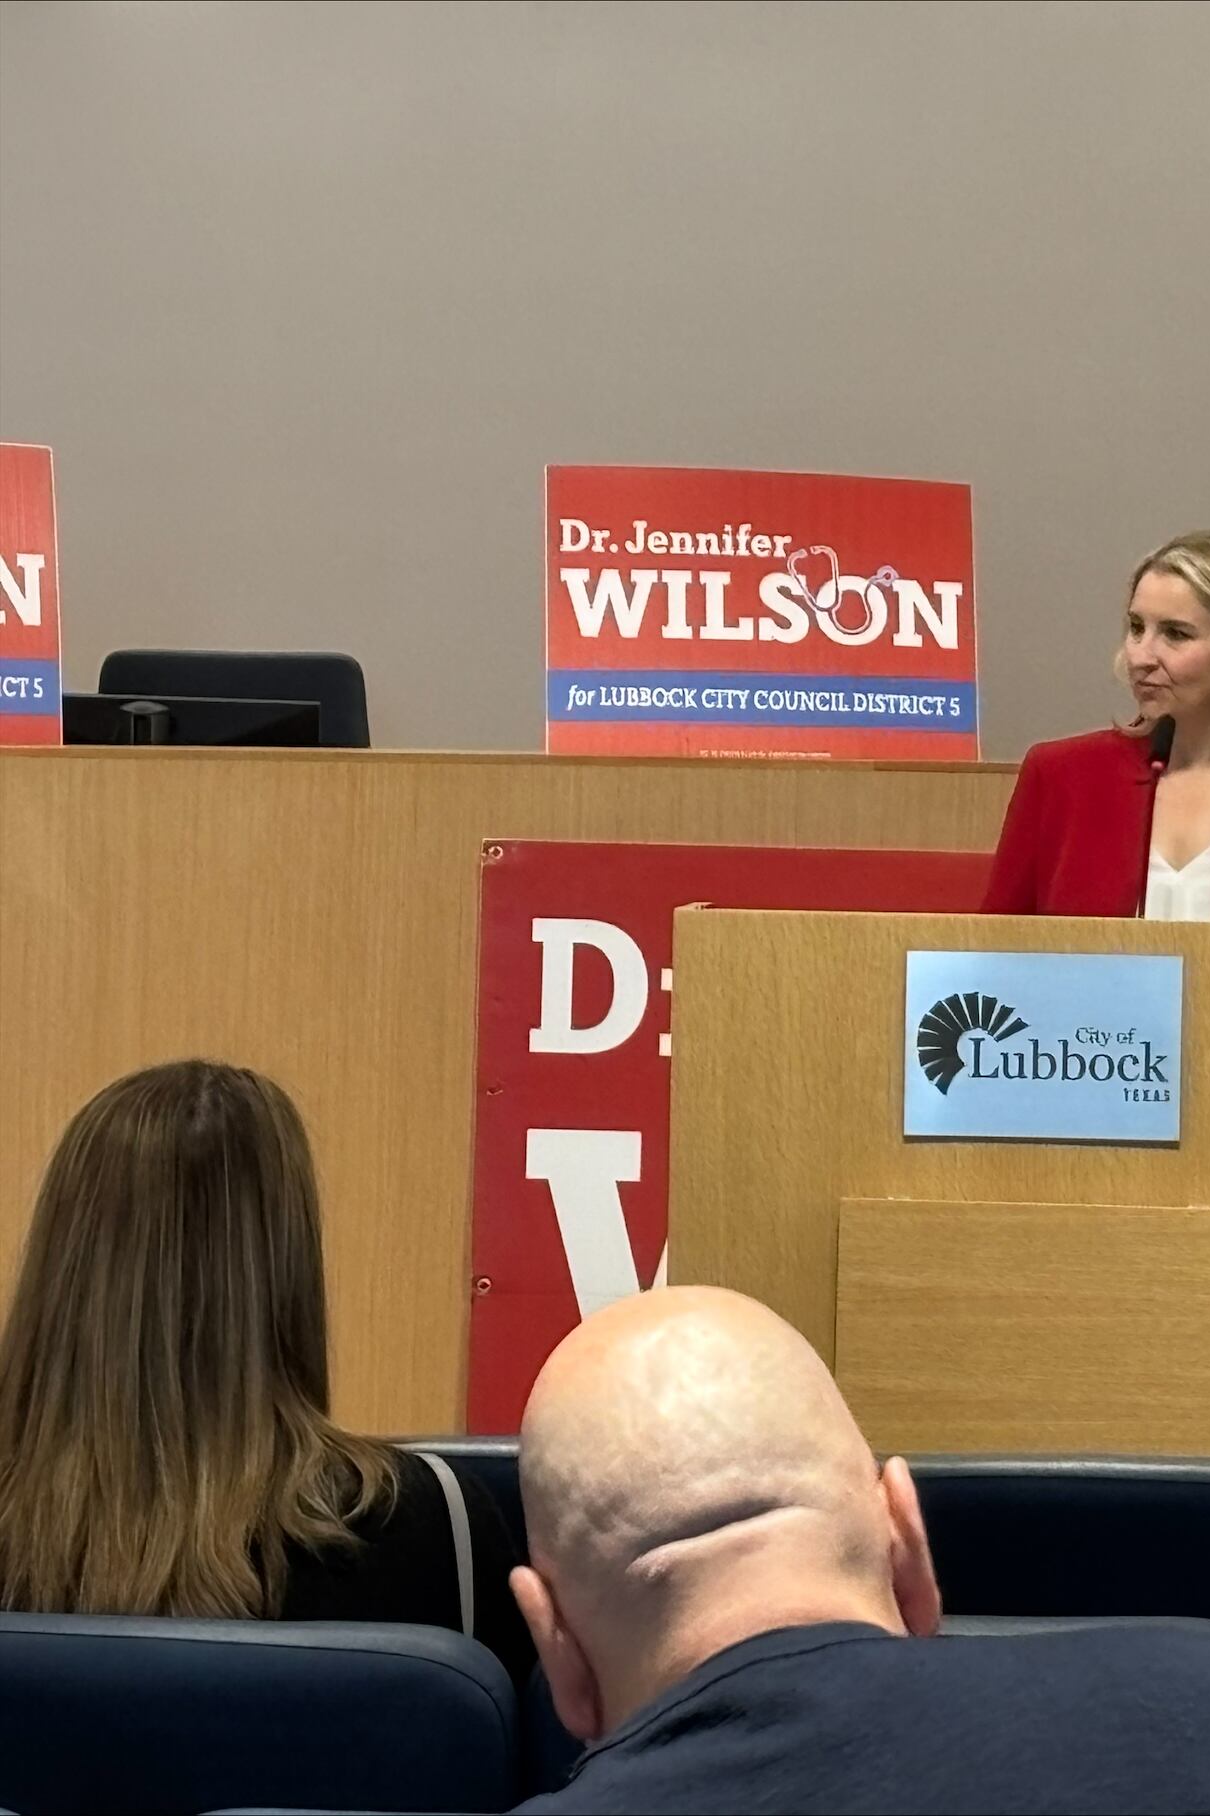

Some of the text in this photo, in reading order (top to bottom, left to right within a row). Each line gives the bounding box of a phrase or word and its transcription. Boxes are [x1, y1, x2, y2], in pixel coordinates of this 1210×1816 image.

[560, 518, 792, 558] Dr. Jennifer
[560, 568, 963, 650] WILSON
[34, 677, 43, 698] 5
[567, 685, 960, 716] for LUBBOCK CITY COUNCIL DISTRICT 5
[1075, 1027, 1136, 1047] City of
[968, 1037, 1168, 1083] Lubbock
